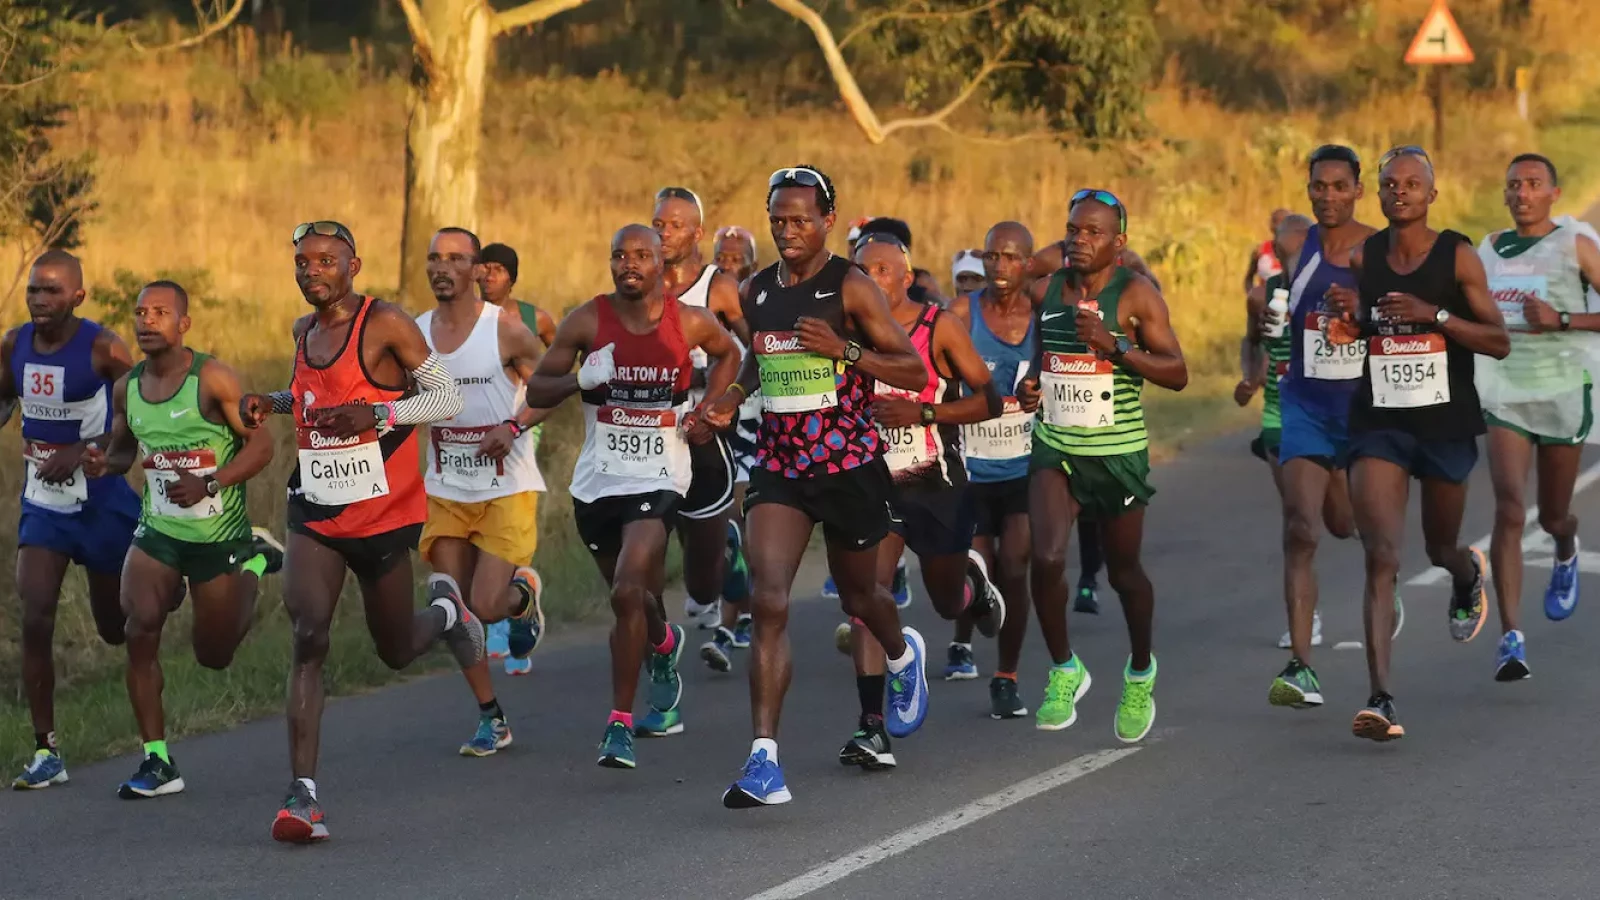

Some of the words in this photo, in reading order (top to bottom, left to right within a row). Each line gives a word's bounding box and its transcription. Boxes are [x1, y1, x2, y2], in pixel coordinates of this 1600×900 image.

[1381, 338, 1431, 354] Bonitas
[1050, 355, 1096, 372] Bonitas
[611, 366, 657, 381] ARLTON
[761, 366, 831, 386] Bongmusa
[1381, 362, 1436, 383] 15954
[31, 372, 54, 396] 35
[455, 377, 492, 386] OBRIK
[779, 386, 805, 396] 31020
[1054, 384, 1093, 403] Mike
[1434, 391, 1444, 402] A
[821, 394, 831, 406] A
[1061, 404, 1085, 413] 54135
[612, 408, 661, 426] Bonitas
[1098, 414, 1108, 425] A
[607, 433, 664, 455] 35918
[622, 453, 647, 463] Given
[311, 457, 370, 479] Calvin
[602, 462, 608, 472] 2
[659, 467, 668, 477] A
[328, 479, 356, 490] 47013
[371, 483, 382, 495] A
[491, 478, 500, 488] A
[208, 505, 217, 515] A
